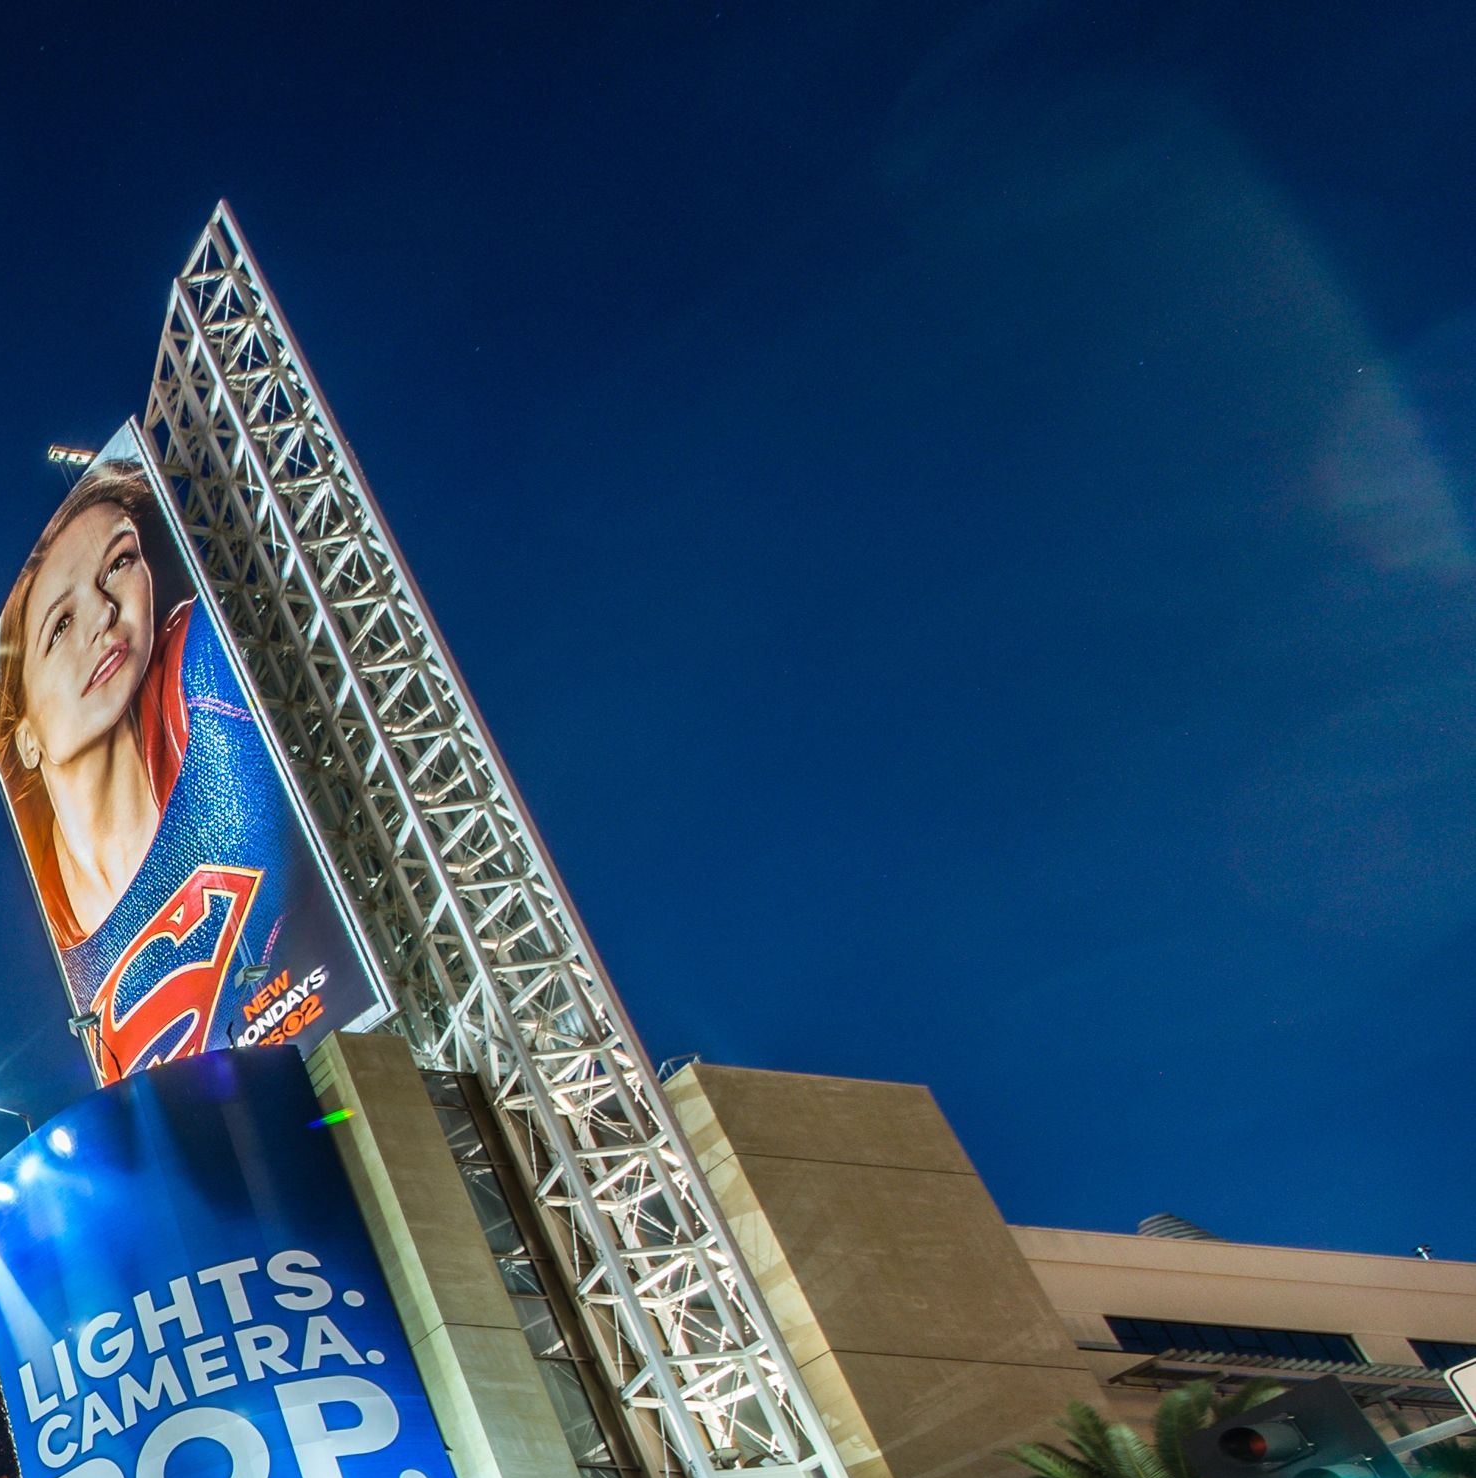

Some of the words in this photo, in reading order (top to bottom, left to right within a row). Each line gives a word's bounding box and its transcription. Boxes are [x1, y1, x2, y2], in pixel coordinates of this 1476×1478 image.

[242, 969, 289, 1022] NEW
[18, 1249, 366, 1425] LIGHTS.
[36, 1314, 387, 1469] CAMERA.
